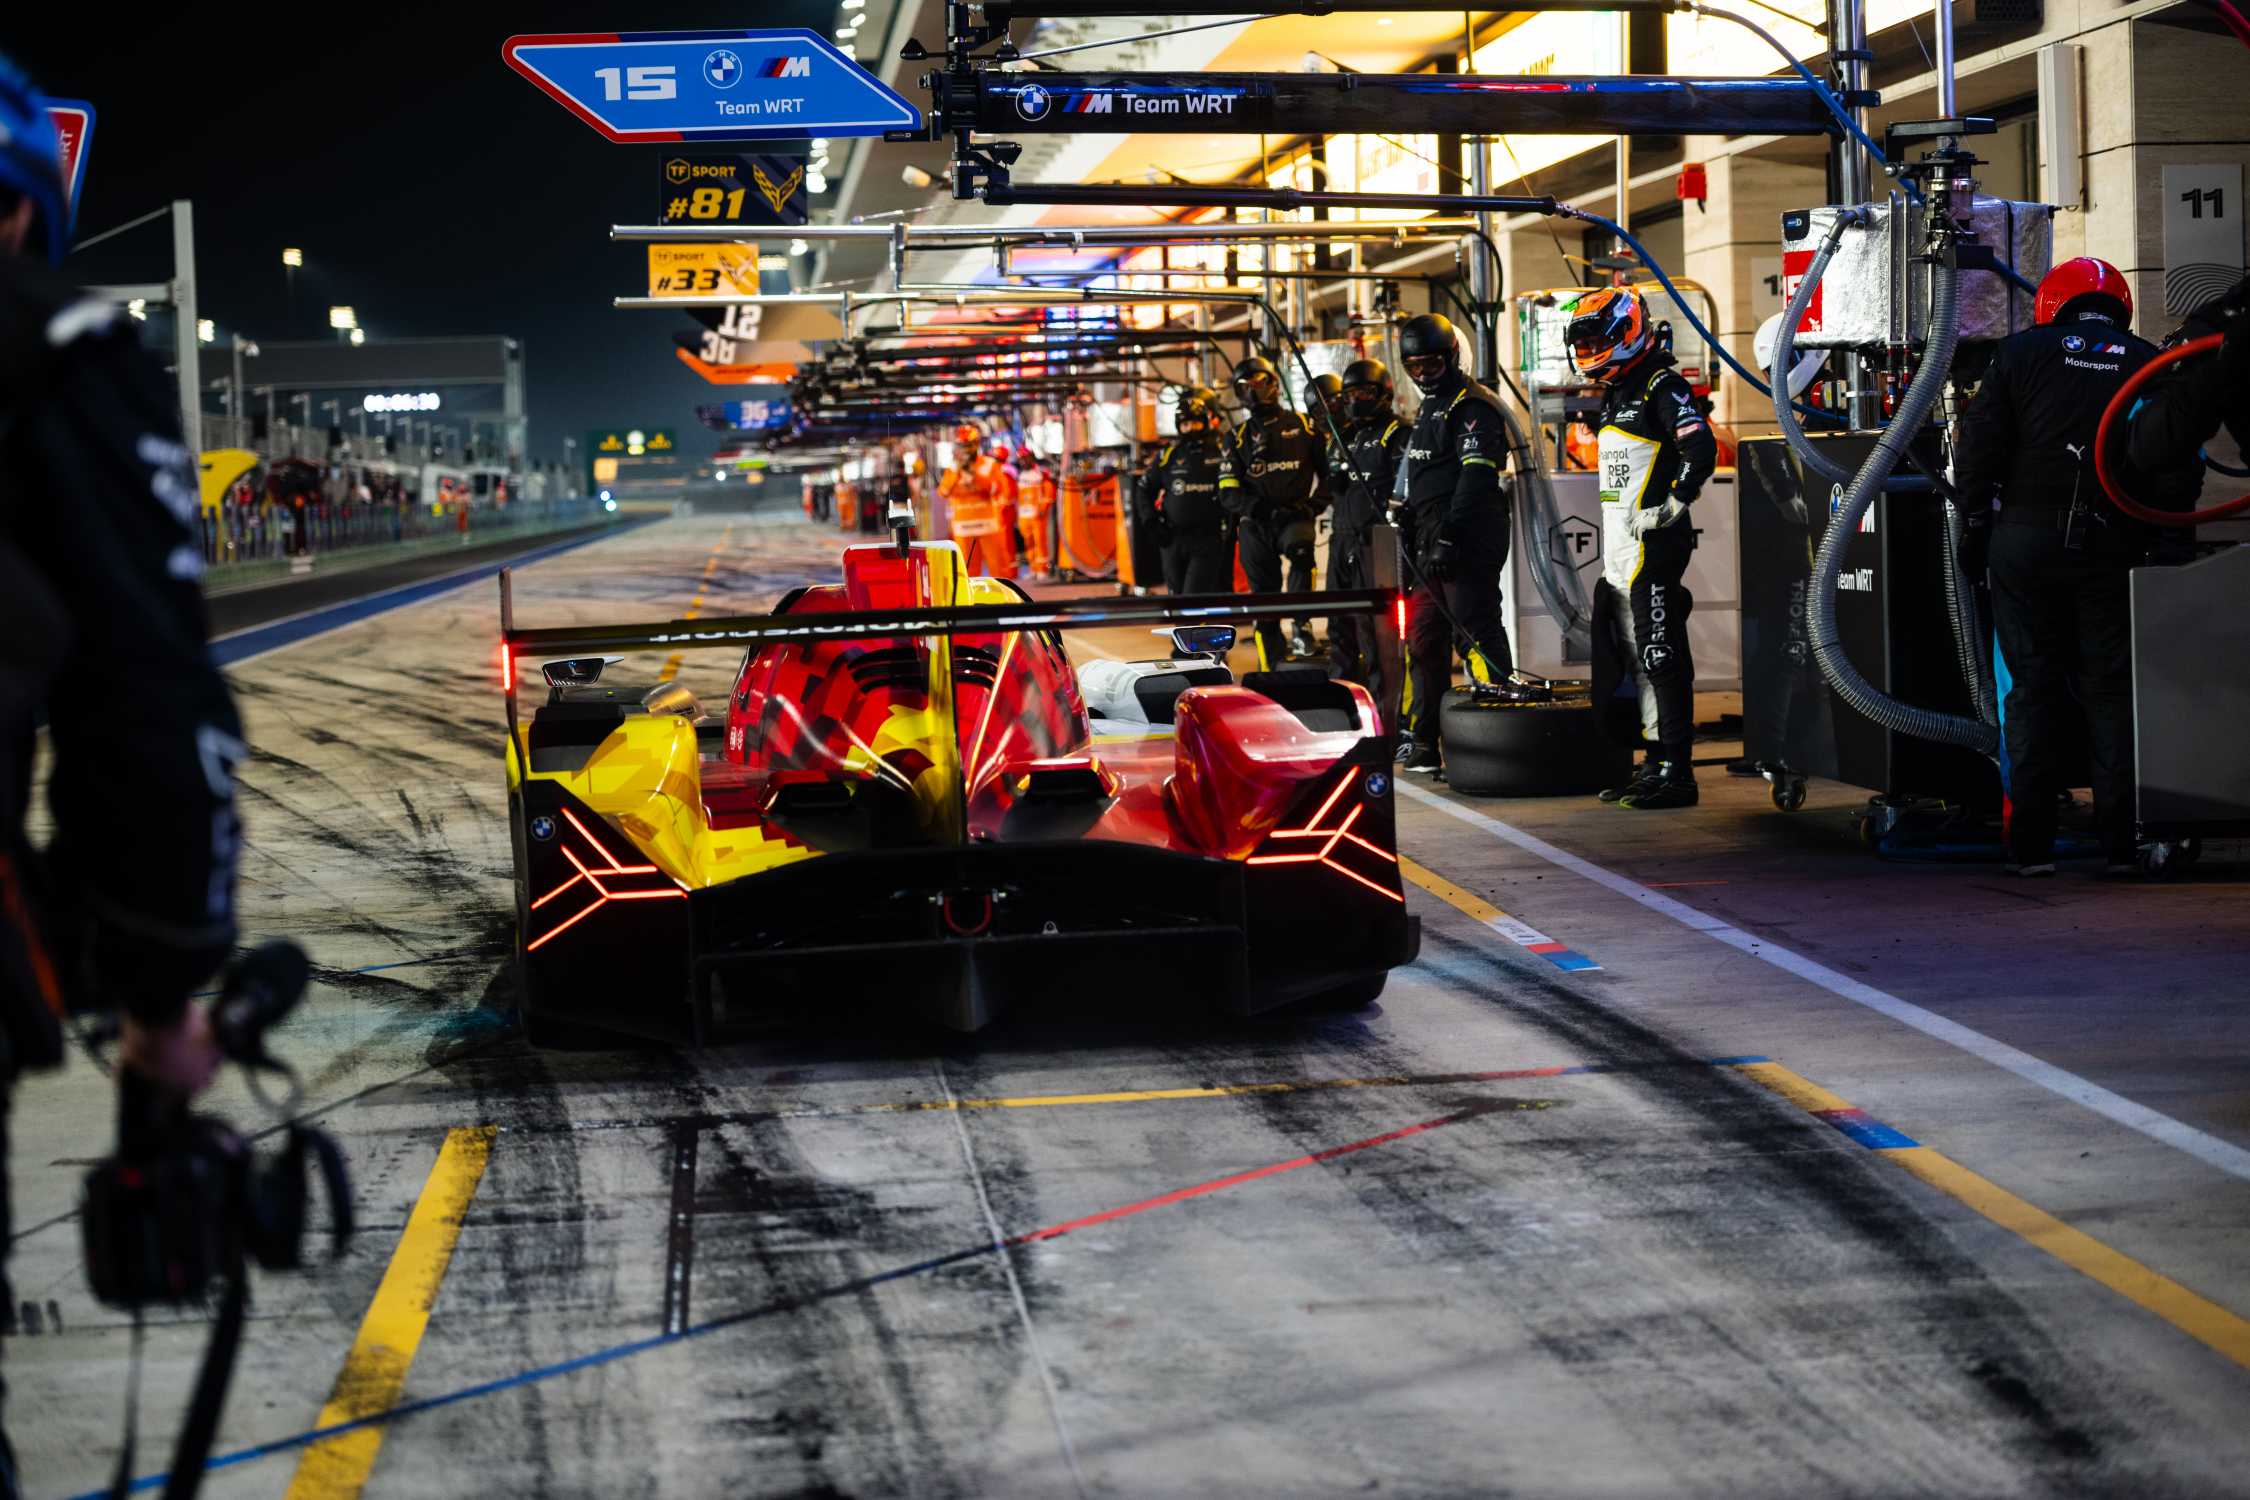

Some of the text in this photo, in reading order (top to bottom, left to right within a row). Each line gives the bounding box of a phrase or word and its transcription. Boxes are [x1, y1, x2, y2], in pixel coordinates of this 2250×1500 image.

[594, 65, 677, 101] 15
[715, 98, 805, 116] Team WRT
[1121, 94, 1179, 113] Team
[1185, 94, 1238, 114] WRT
[59, 128, 74, 161] RT
[670, 165, 737, 177] TF SPORT
[667, 187, 747, 220] #81
[2181, 188, 2223, 218] 11
[657, 268, 722, 291] #33
[1763, 274, 1783, 296] 1
[2064, 356, 2120, 371] Motorsport
[1855, 568, 1874, 592] WRT
[1650, 583, 1666, 642] SPORT
